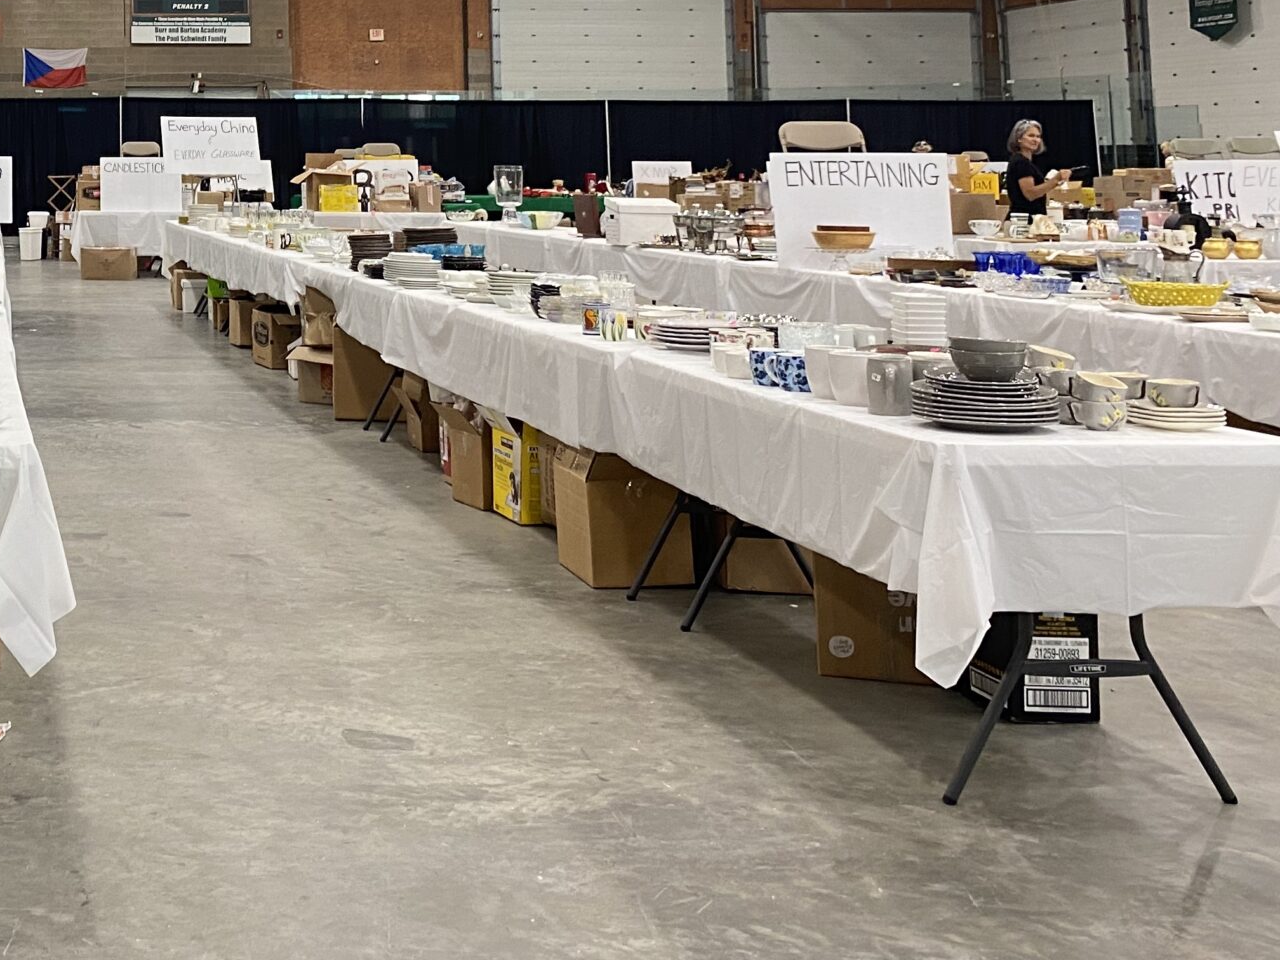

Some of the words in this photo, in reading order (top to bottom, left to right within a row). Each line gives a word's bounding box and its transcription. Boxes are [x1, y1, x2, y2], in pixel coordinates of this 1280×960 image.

[200, 27, 227, 35] Academy
[155, 35, 166, 43] The
[167, 120, 218, 137] Everyday
[784, 160, 940, 188] ENTERTAINING
